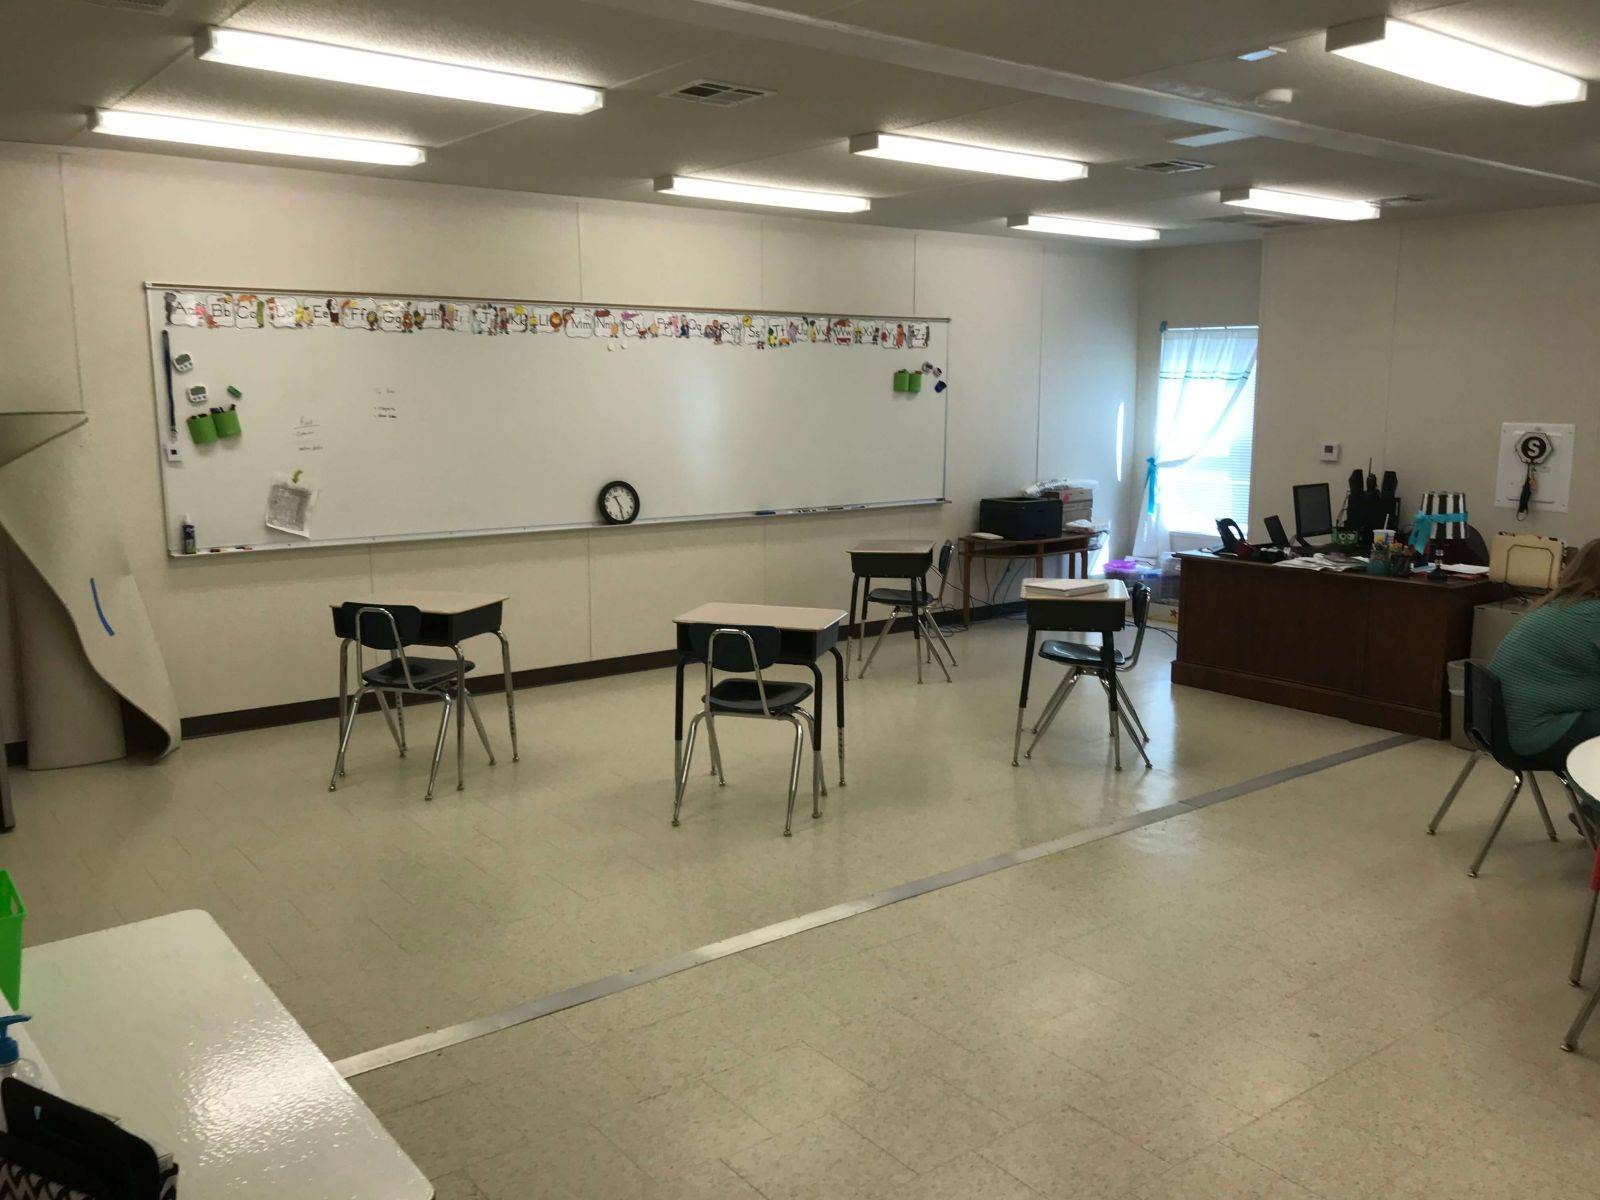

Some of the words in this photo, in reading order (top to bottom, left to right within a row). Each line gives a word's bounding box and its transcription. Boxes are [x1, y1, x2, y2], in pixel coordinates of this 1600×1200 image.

[212, 303, 231, 317] Bb
[313, 305, 329, 319] Ee
[1526, 439, 1541, 457] S
